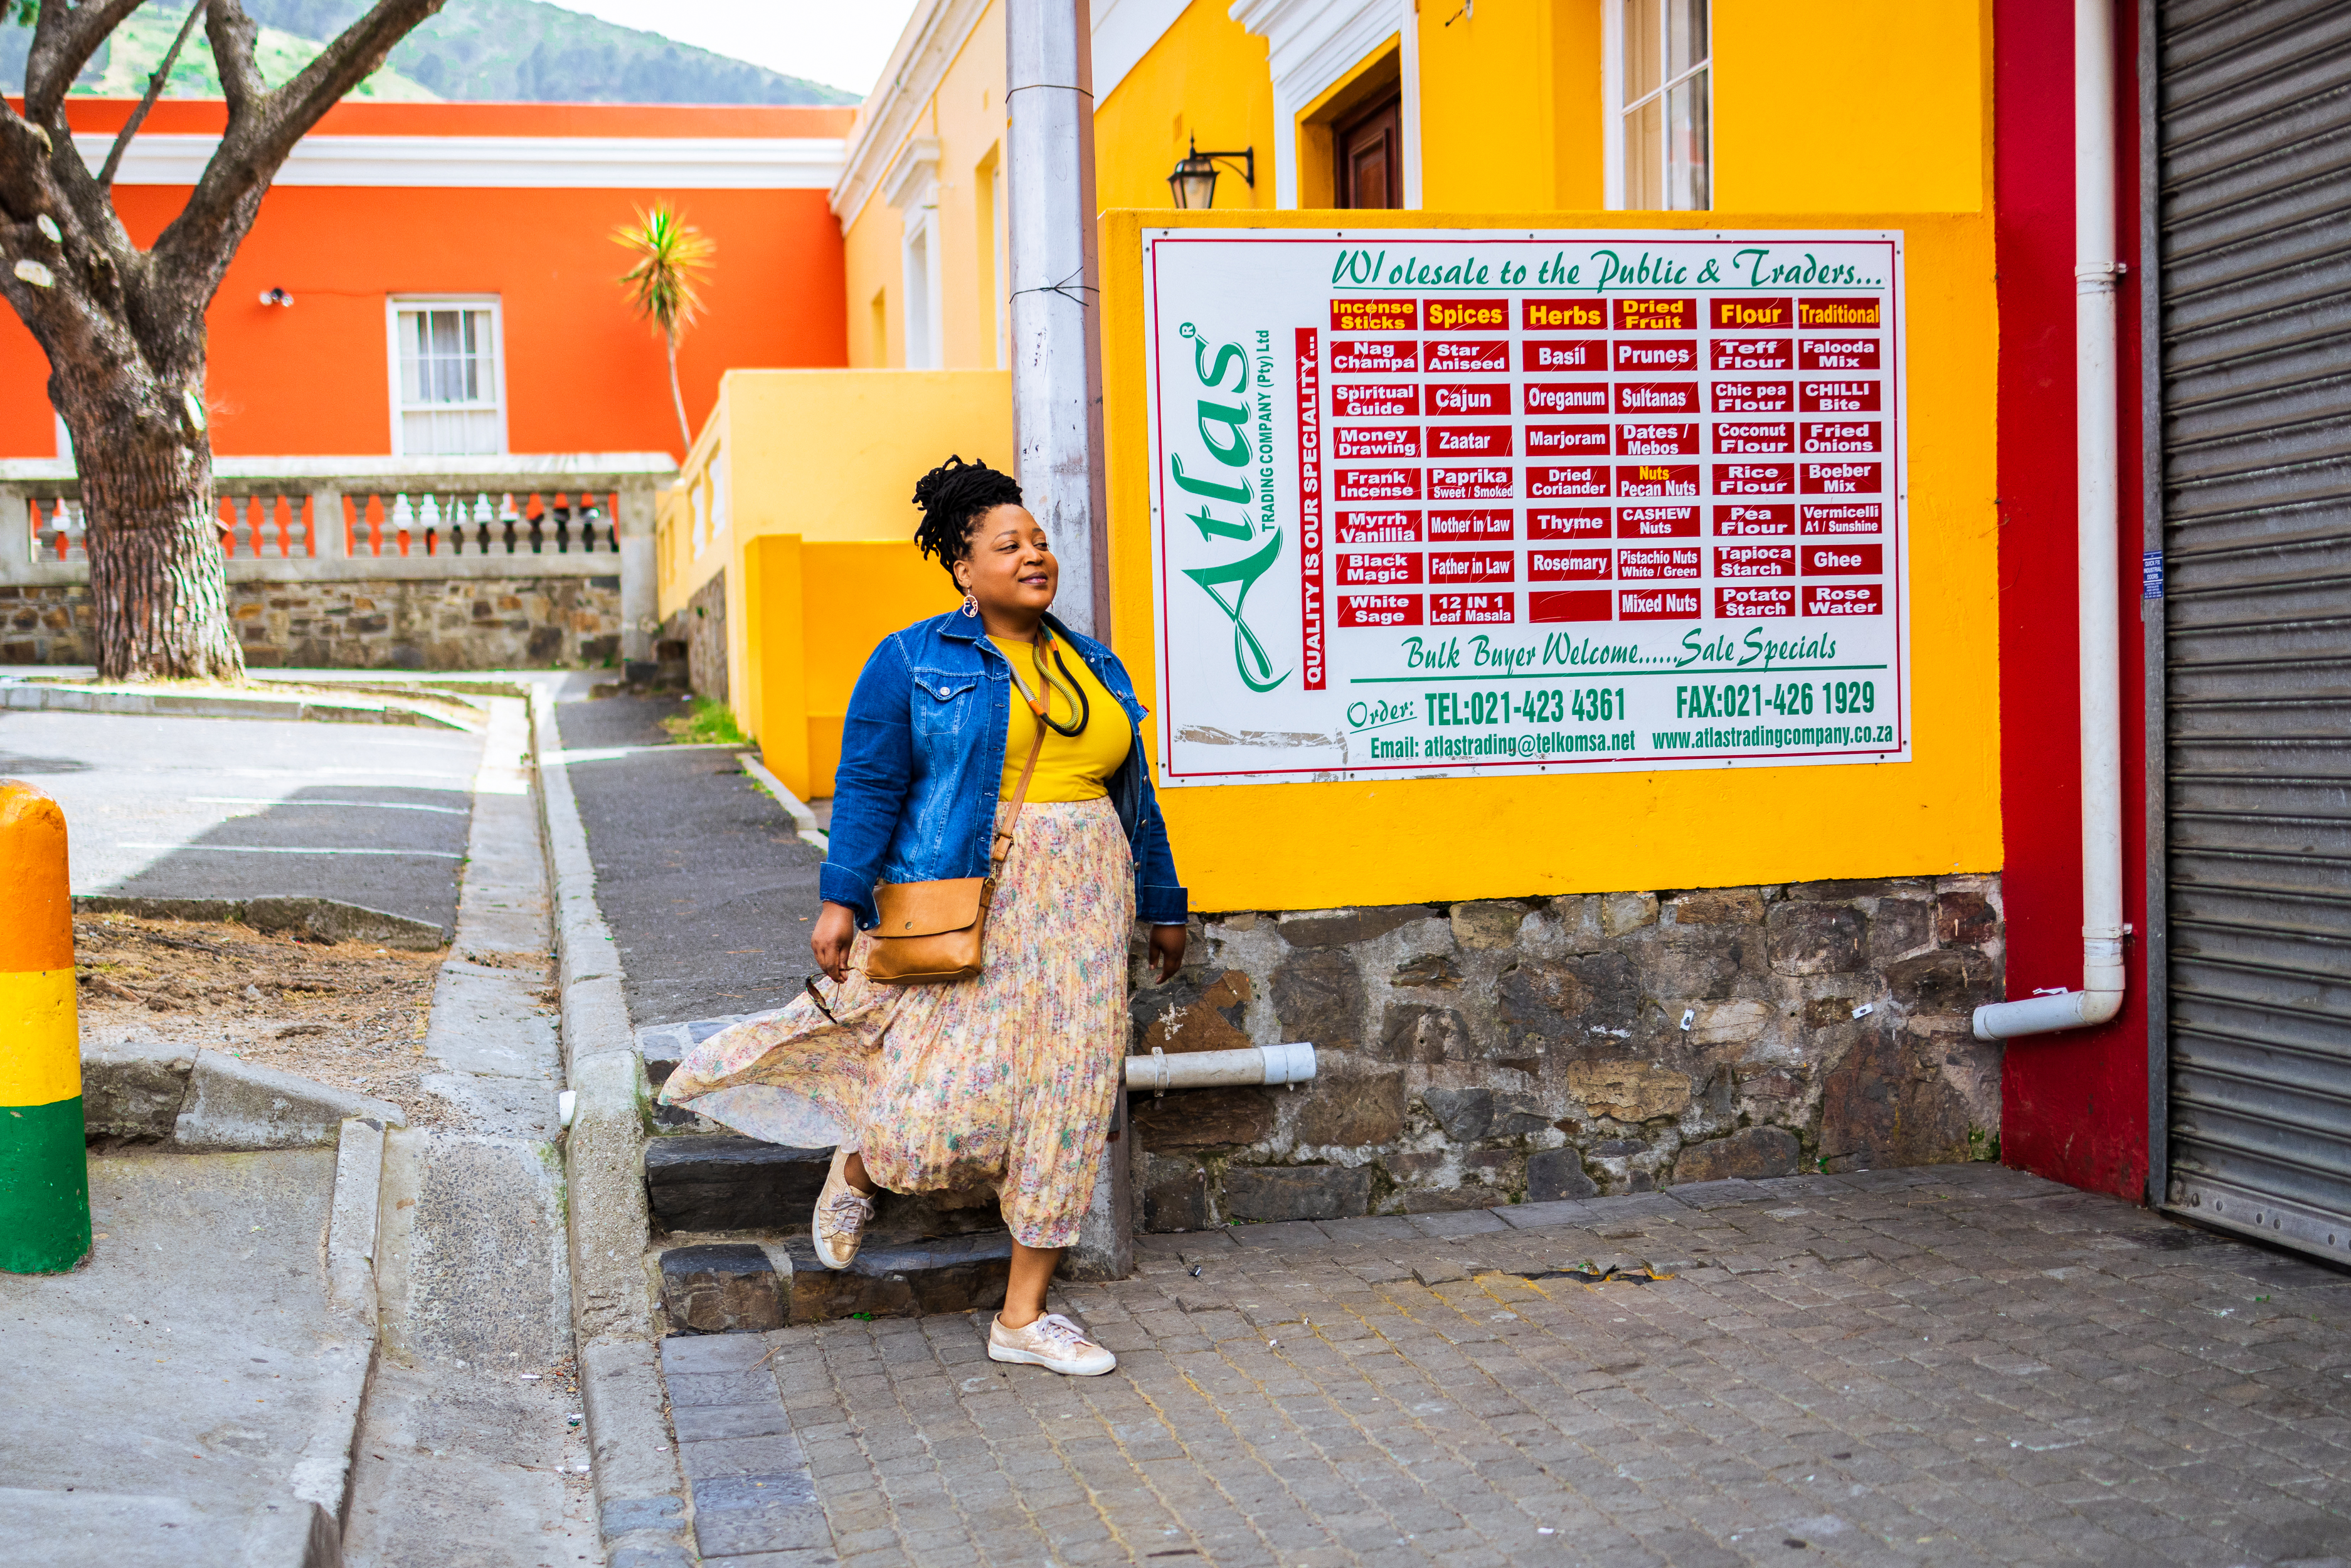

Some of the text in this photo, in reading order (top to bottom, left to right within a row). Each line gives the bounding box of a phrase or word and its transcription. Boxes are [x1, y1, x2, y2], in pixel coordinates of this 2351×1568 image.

[1500, 261, 1527, 285] to
[1539, 252, 1579, 284] the
[1591, 250, 1687, 293] Public
[1697, 258, 1720, 283] &
[1333, 300, 1414, 314] Incense
[1623, 300, 1683, 312] Dried
[1430, 304, 1502, 328] Spices
[1531, 306, 1600, 324] Herbs
[1722, 305, 1781, 324] Flour
[1800, 305, 1879, 323] Traditional
[1341, 317, 1404, 329] Sticks
[1627, 316, 1681, 328] Fruit
[1354, 342, 1394, 358] Nag
[1438, 344, 1480, 356] Star
[1720, 342, 1777, 354] Teff
[1804, 341, 1874, 352] Falooda
[1539, 347, 1584, 365] Basil
[1620, 346, 1689, 363] Prunes
[1820, 356, 1859, 367] Mix
[1333, 356, 1415, 370] Champa
[1428, 358, 1504, 370] Aniseed
[1719, 357, 1785, 368] Flour
[1337, 386, 1413, 401] Spiritual
[1716, 384, 1786, 398] Chic pea
[1806, 383, 1869, 396] CHILLI
[1436, 389, 1490, 412] Cajun
[1529, 388, 1605, 411] Oreganum
[1623, 389, 1685, 407] Sultanas
[1719, 399, 1785, 410] Flour
[1820, 399, 1860, 410] Bite
[1347, 402, 1404, 415] Guide
[1256, 331, 1275, 532] TRADING COMPANY (Pty) Ltd
[1341, 430, 1408, 445] Money
[1624, 425, 1677, 438] Dates
[1719, 424, 1785, 437] Coconut
[1812, 425, 1869, 437] Fried
[1440, 432, 1490, 448] Zaatar
[1531, 431, 1605, 448] Marjoram
[1722, 440, 1788, 452] Flour
[1805, 439, 1873, 452] Onions
[1339, 442, 1415, 456] Drawing
[1628, 441, 1678, 455] Mebos
[1347, 472, 1406, 484] Frank
[1433, 469, 1507, 485] Paprika
[1549, 469, 1590, 481] Dried
[1640, 466, 1669, 480] Nuts
[1729, 466, 1778, 478] Rice
[1810, 464, 1871, 478] Boeber
[1341, 485, 1413, 497] Incense
[1432, 486, 1465, 498] Sweet
[1474, 485, 1512, 497] Smoked
[1532, 482, 1606, 495] Coriander
[1621, 481, 1696, 497] Pecan Nuts
[1721, 481, 1787, 492] Flour
[1825, 480, 1855, 492] Mix
[1171, 334, 1295, 692] Atlas
[1301, 336, 1322, 683] QUALITY IS OUR SPECIALITY...
[1623, 507, 1690, 520] CASHEW
[1731, 507, 1771, 521] Pea
[1803, 506, 1878, 518] Vermicelli
[1349, 513, 1406, 527] Myrrh
[1431, 516, 1510, 532] Mother in Law
[1537, 516, 1603, 532] Thyme
[1805, 521, 1818, 532] A1
[1829, 521, 1877, 532] Sunshine
[1340, 526, 1415, 543] Vanillia
[1640, 522, 1671, 534] Nuts
[1722, 522, 1788, 534] Flour
[1350, 554, 1407, 566] Black
[1621, 551, 1697, 564] Pistachio Nuts
[1719, 546, 1791, 562] Tapioca
[1814, 552, 1861, 567] Ghee
[1433, 558, 1510, 575] Father in Law
[1534, 555, 1607, 573] Rosemary
[1622, 566, 1654, 576] White
[1664, 566, 1696, 576] Green
[1721, 563, 1781, 576] Starch
[1347, 568, 1408, 583] Magic
[1724, 589, 1791, 601] Potato
[1817, 588, 1870, 600] Rose
[1350, 596, 1409, 608] White
[1440, 596, 1502, 608] 12 IN 1
[1623, 594, 1697, 612] Mixed Nuts
[1809, 601, 1876, 614] Water
[1433, 610, 1510, 622] Leaf Masala
[1726, 603, 1785, 616] Starch
[1356, 611, 1404, 625] Sage
[1401, 637, 1460, 669] Bulk
[1468, 634, 1536, 676] Buyer
[1737, 627, 1836, 672] Specials
[1572, 688, 1624, 721] 4361
[1823, 681, 1874, 714] 1929
[1347, 700, 1416, 728] Order:
[1371, 731, 1635, 758] Email: atlastrading@telkomsa.net
[1652, 726, 1892, 749] www.atlastradingcompany.co.za
